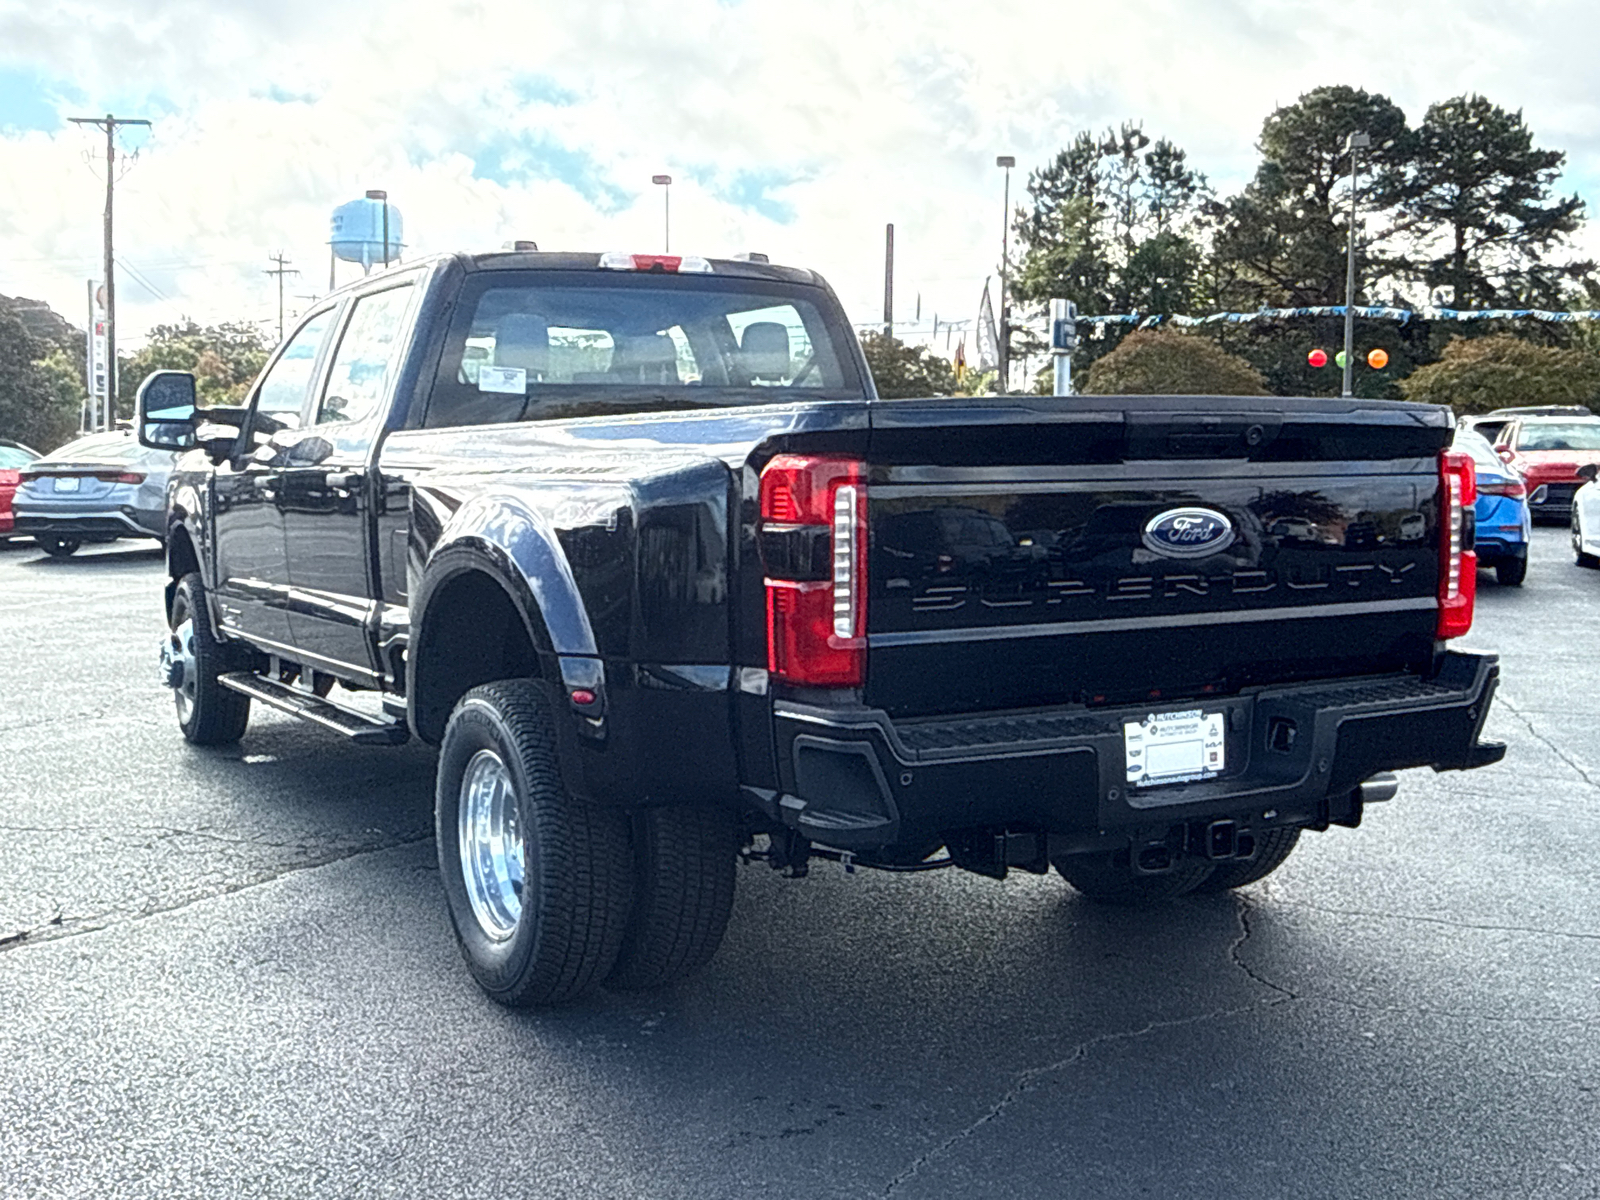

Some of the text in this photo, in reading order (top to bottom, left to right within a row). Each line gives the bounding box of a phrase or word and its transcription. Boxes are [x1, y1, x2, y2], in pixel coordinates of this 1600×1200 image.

[1168, 517, 1215, 541] Ford
[911, 562, 1416, 611] SUPER DUTY
